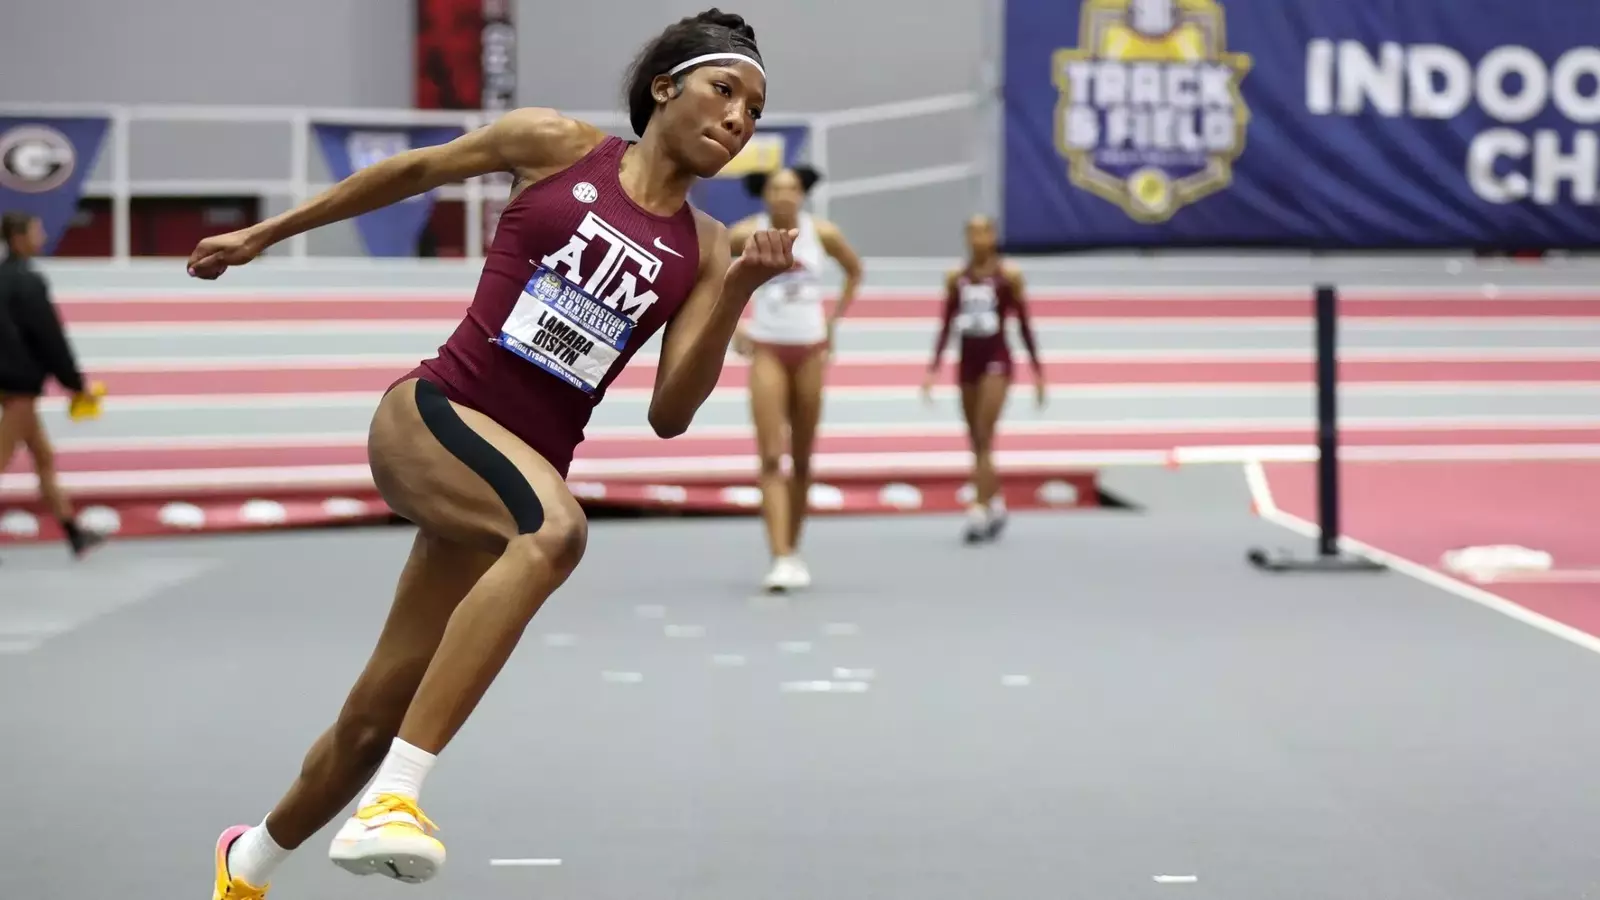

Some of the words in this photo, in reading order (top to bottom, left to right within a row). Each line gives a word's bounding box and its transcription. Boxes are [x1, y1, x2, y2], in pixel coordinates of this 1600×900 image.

[1067, 62, 1232, 107] TRACK
[1065, 107, 1099, 150] &
[1106, 108, 1237, 150] FIELD
[557, 294, 621, 340] CONFERENCE
[562, 285, 627, 331] SOUTHEASTERN
[531, 328, 579, 366] DISTIN
[537, 310, 594, 355] LAMARA
[526, 349, 547, 365] TYSON
[545, 360, 565, 376] TRACK
